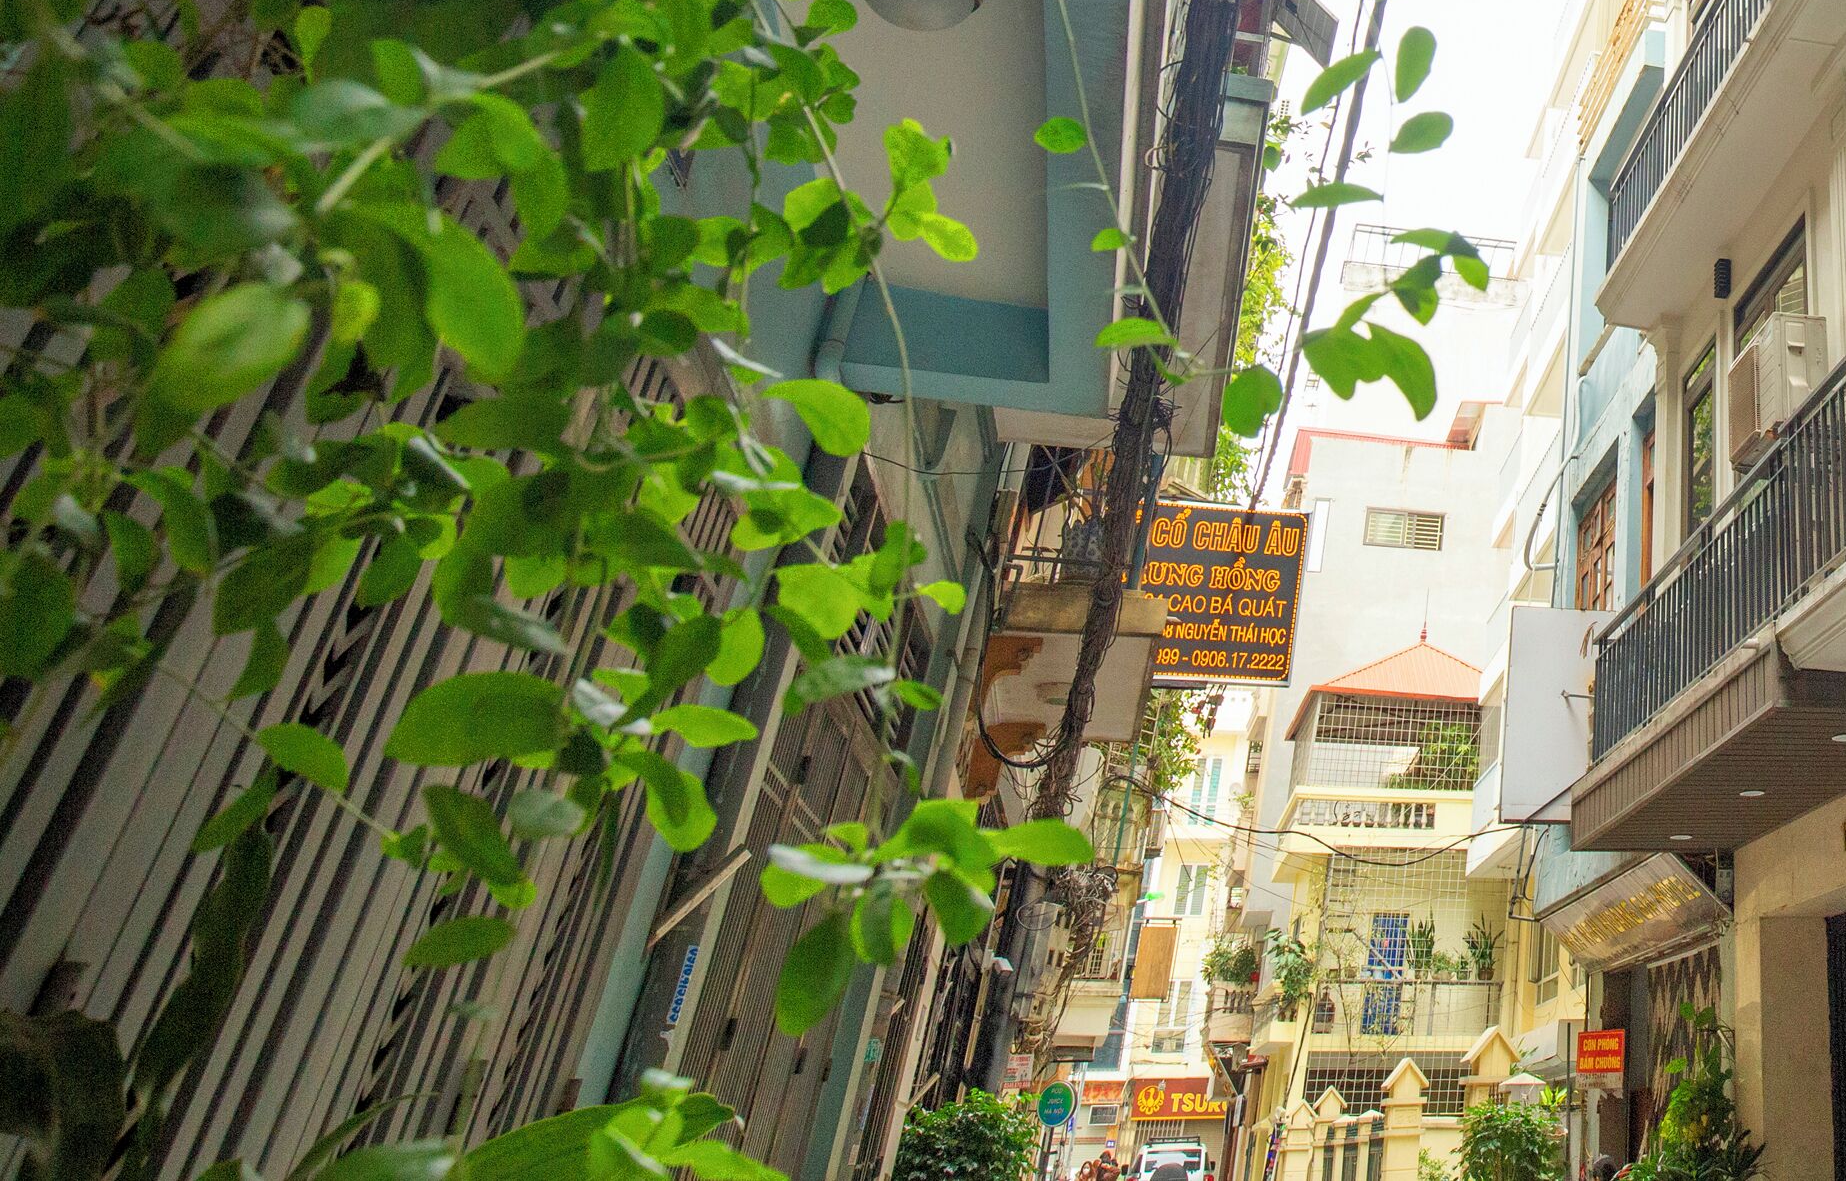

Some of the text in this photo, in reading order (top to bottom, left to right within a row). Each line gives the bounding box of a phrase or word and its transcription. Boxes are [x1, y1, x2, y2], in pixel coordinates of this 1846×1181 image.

[1193, 517, 1260, 554] CHÂU
[1264, 520, 1300, 557] ÂU
[1209, 557, 1281, 593] HỒNG
[1168, 593, 1287, 618] CAO BÁ QUÁT
[1175, 619, 1228, 641] NGUYỄN
[1230, 623, 1258, 643] THÁI
[1260, 628, 1286, 647] HỌC
[1192, 650, 1285, 669] 0906.17.2222
